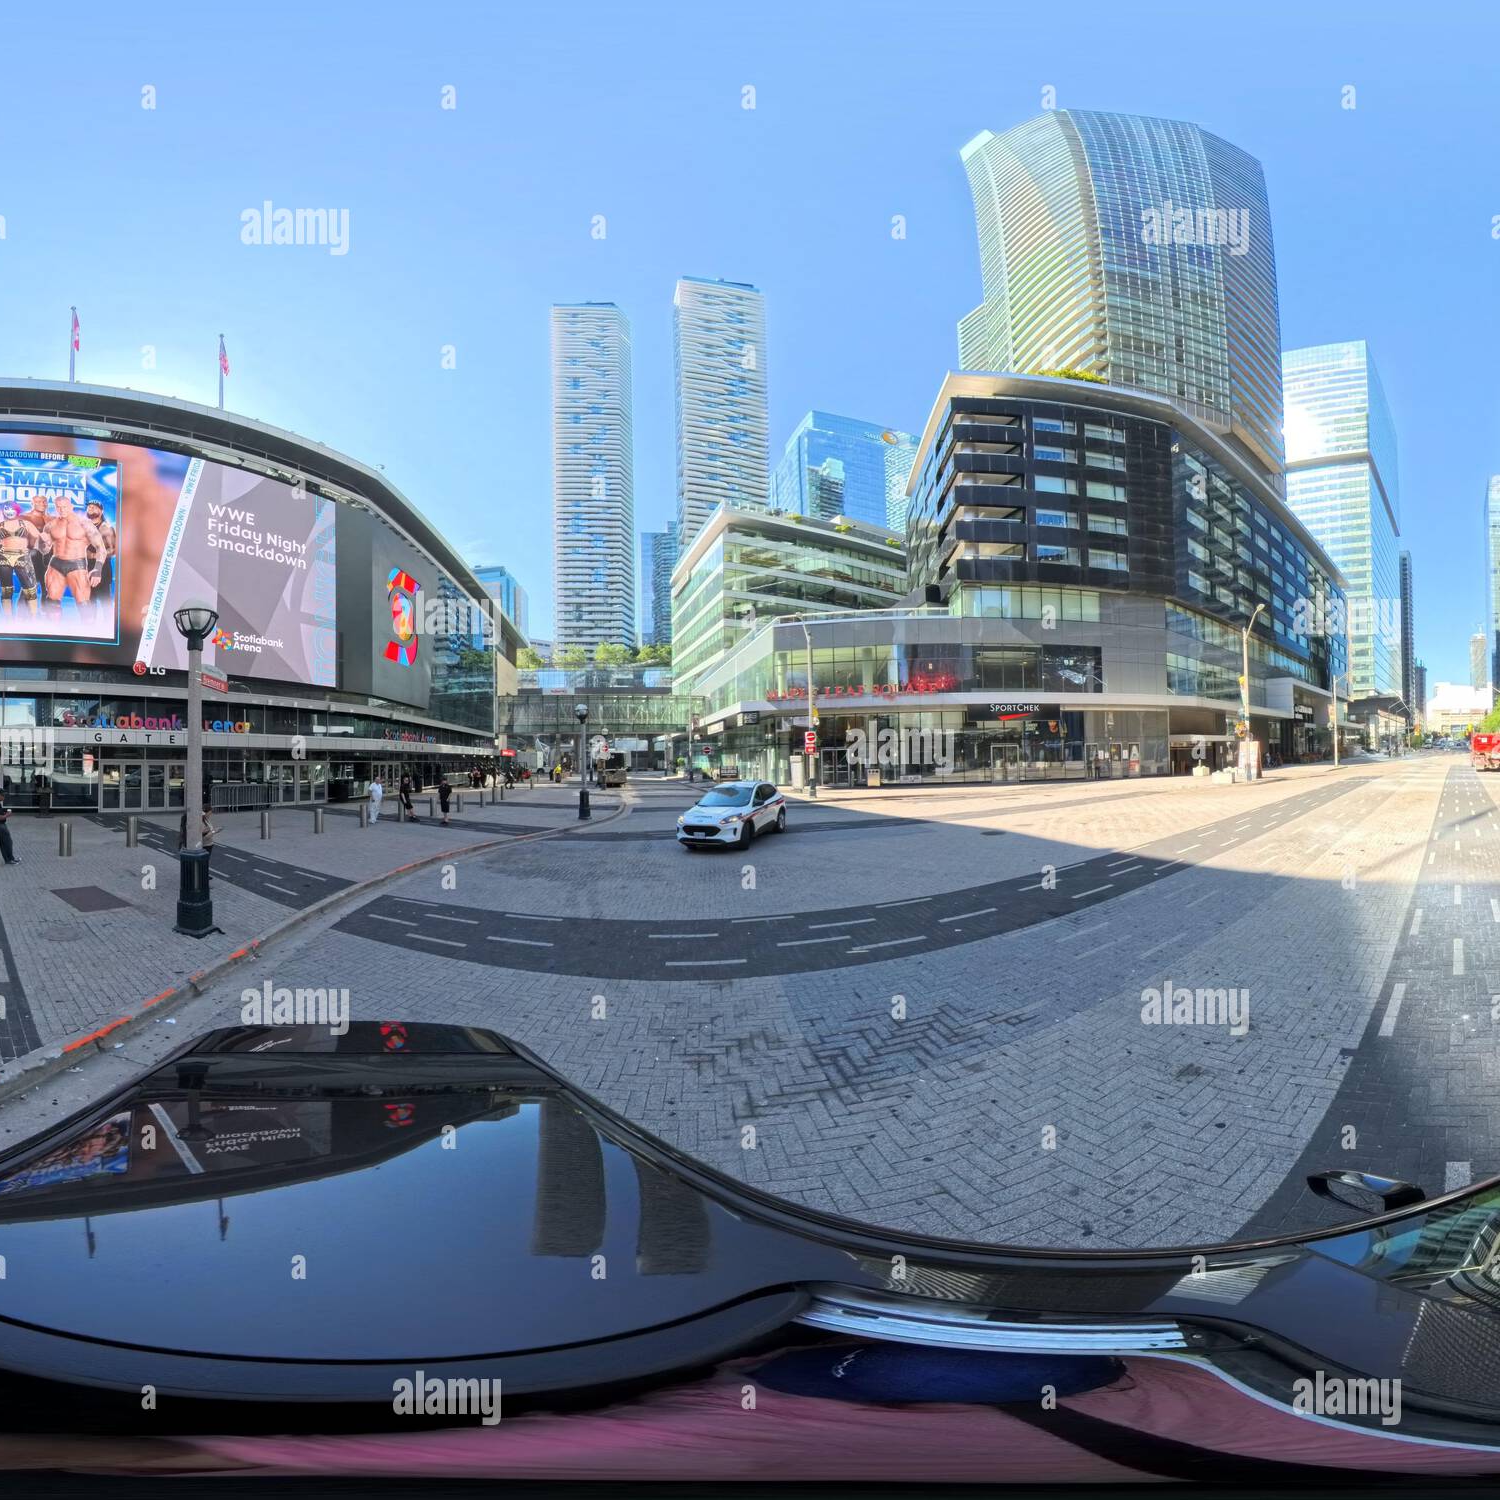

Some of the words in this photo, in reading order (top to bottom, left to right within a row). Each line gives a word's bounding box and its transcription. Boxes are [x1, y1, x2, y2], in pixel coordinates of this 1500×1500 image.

[40, 453, 65, 461] BEFORE
[207, 503, 255, 526] WWE
[166, 507, 187, 559] SMACKDOWN
[207, 519, 262, 545] Friday
[266, 532, 307, 555] Night
[207, 534, 307, 570] Smackdown
[160, 558, 173, 587] NIGHT
[154, 585, 165, 617] FRIDAY
[233, 631, 284, 649] Scotiabank
[233, 642, 262, 653] Arena
[149, 666, 166, 675] LG
[766, 685, 818, 700] MAPLE
[824, 684, 864, 698] LEAF
[872, 680, 938, 696] SQUARE
[62, 711, 182, 731] Scotiabank
[203, 719, 250, 733] rena
[94, 733, 176, 744] GATE
[384, 728, 420, 742] Scotiabank
[421, 732, 436, 744] Arena
